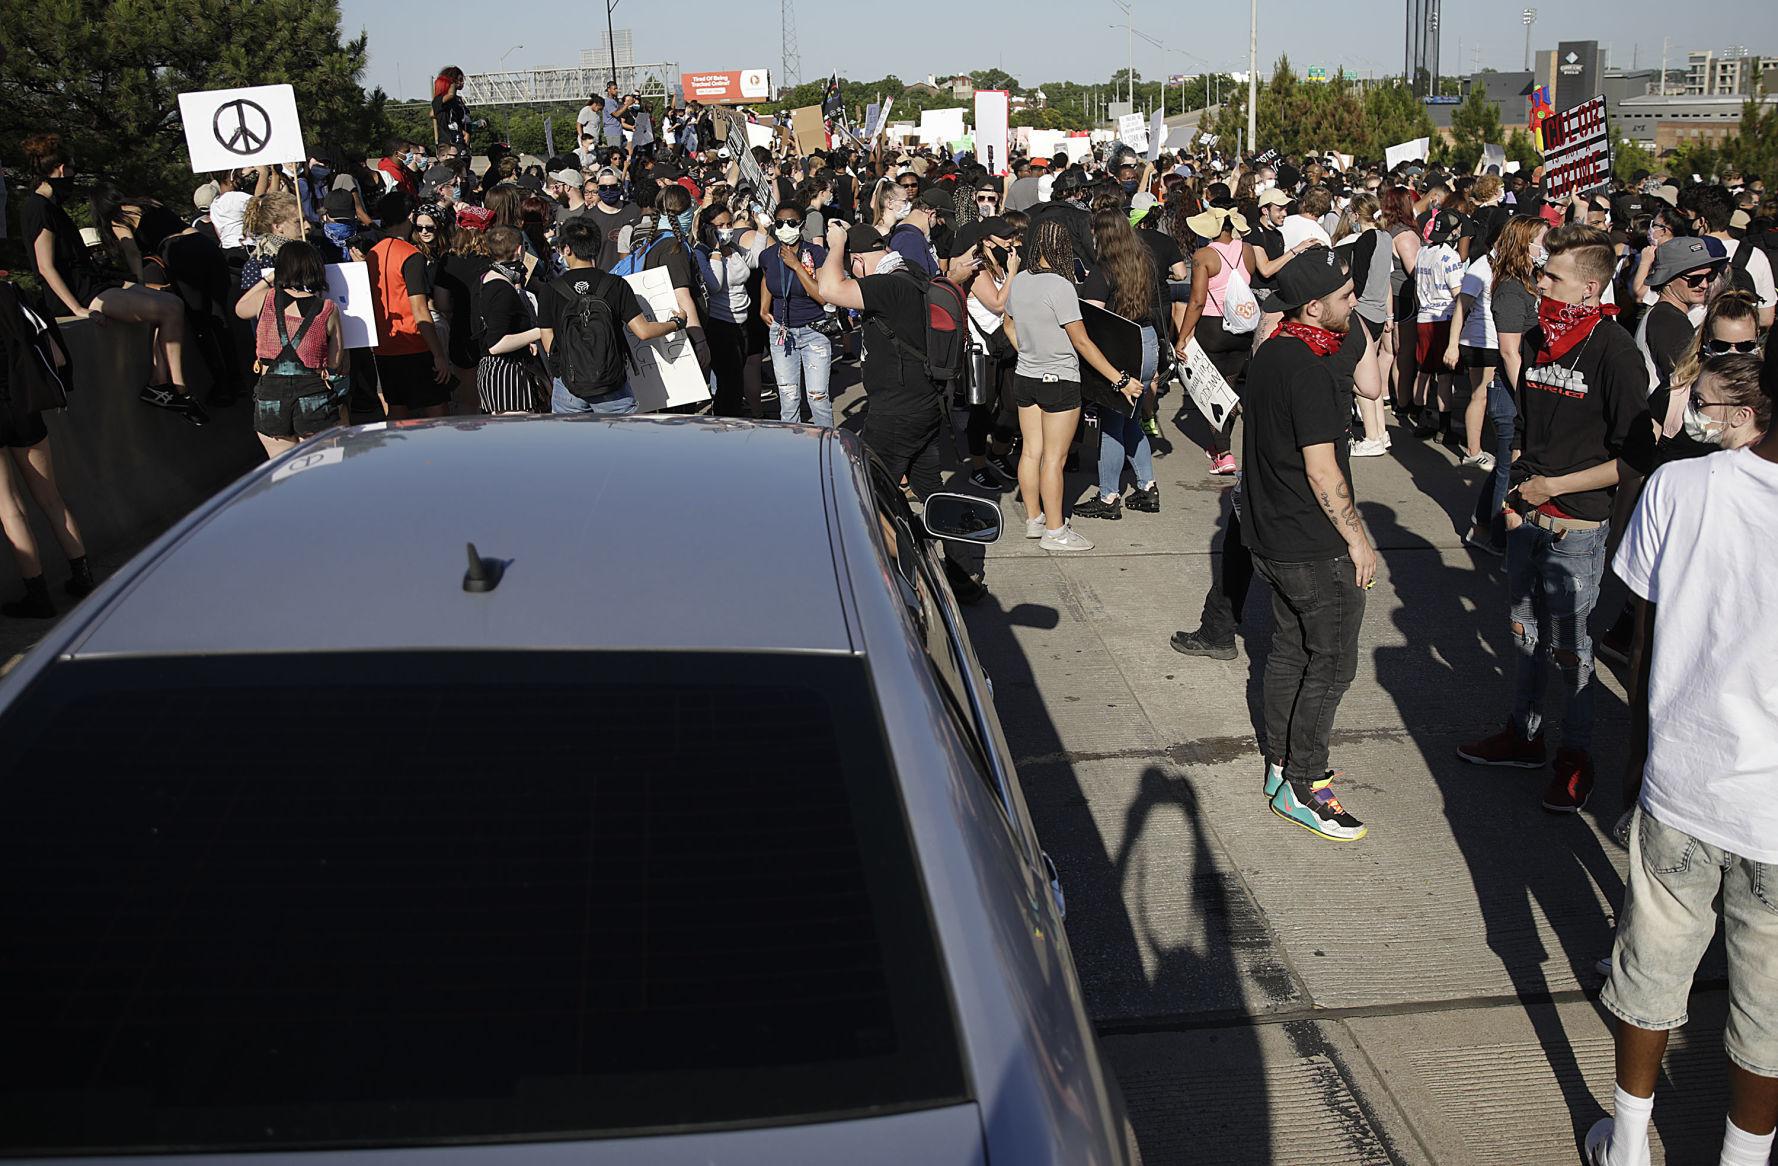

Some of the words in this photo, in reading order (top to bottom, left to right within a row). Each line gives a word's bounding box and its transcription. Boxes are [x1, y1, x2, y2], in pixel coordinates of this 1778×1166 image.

[1546, 100, 1601, 151] COLOR
[1552, 152, 1560, 164] IS
[1551, 149, 1603, 199] CRIME
[1444, 261, 1463, 274] NAS
